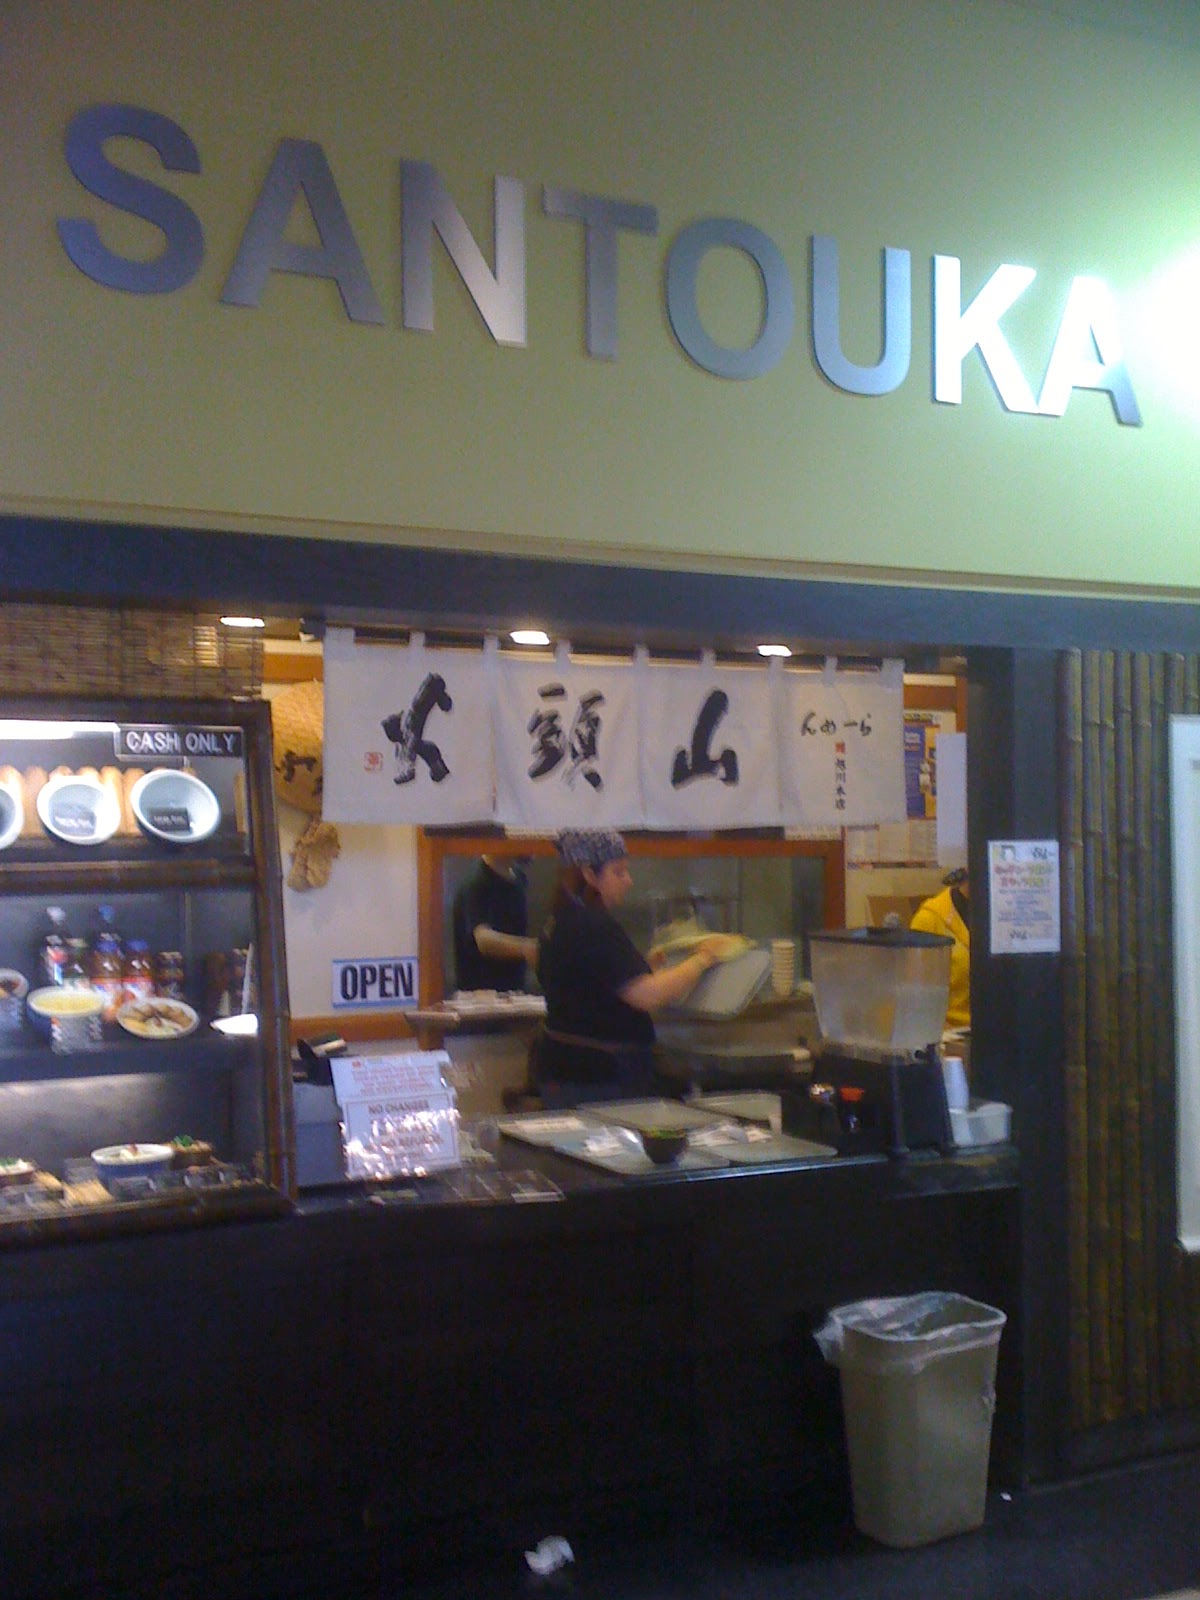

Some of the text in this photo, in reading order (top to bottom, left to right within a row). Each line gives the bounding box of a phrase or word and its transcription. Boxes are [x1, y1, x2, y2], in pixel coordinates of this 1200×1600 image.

[56, 103, 1142, 427] SANTOUKA
[126, 731, 236, 752] CASH ONLY
[340, 962, 413, 1000] OPEN
